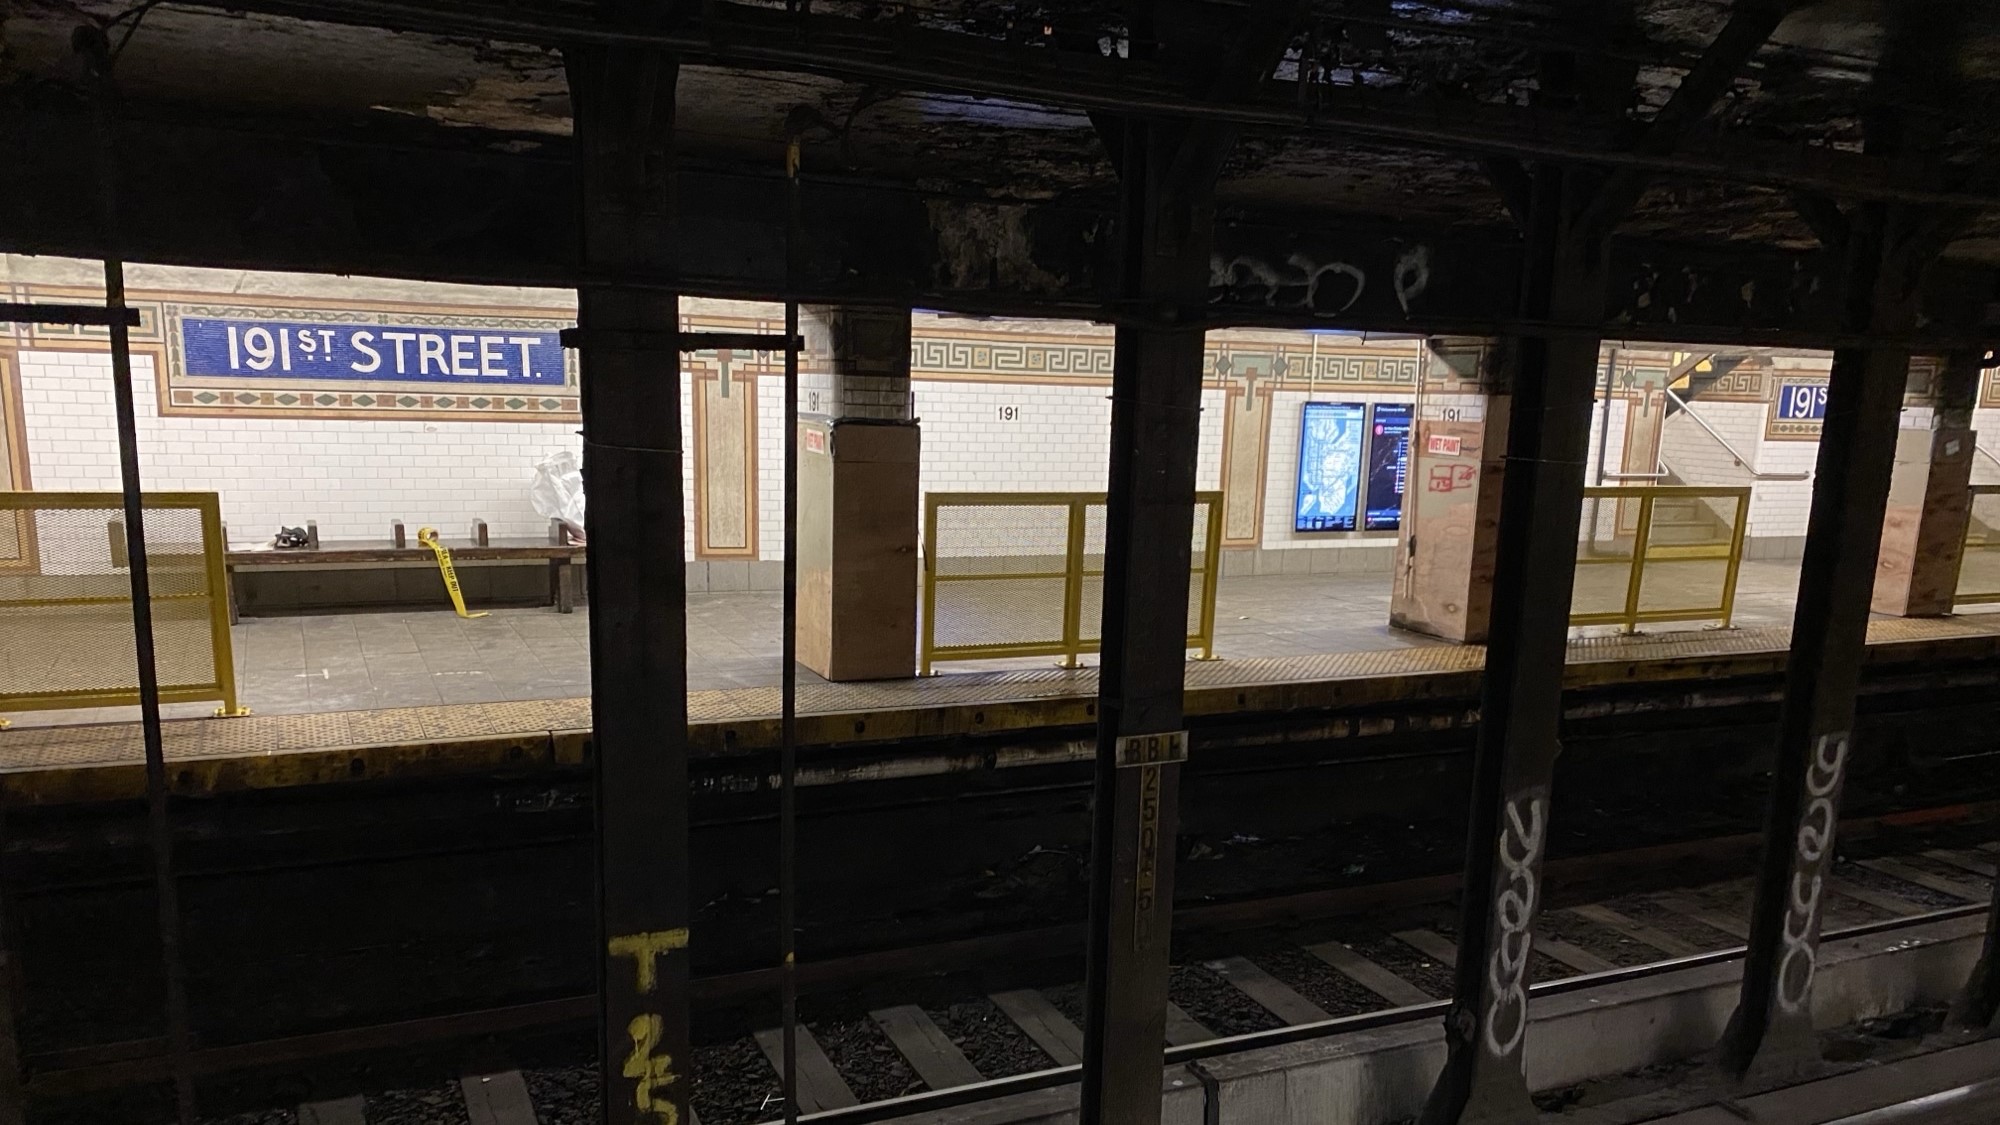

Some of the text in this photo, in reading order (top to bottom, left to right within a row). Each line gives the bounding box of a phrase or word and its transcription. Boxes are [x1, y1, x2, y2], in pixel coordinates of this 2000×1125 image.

[808, 392, 820, 412] 191
[998, 406, 1019, 421] 191
[1442, 408, 1461, 423] 191
[1430, 437, 1460, 453] WET PAINT
[450, 580, 459, 592] OUT
